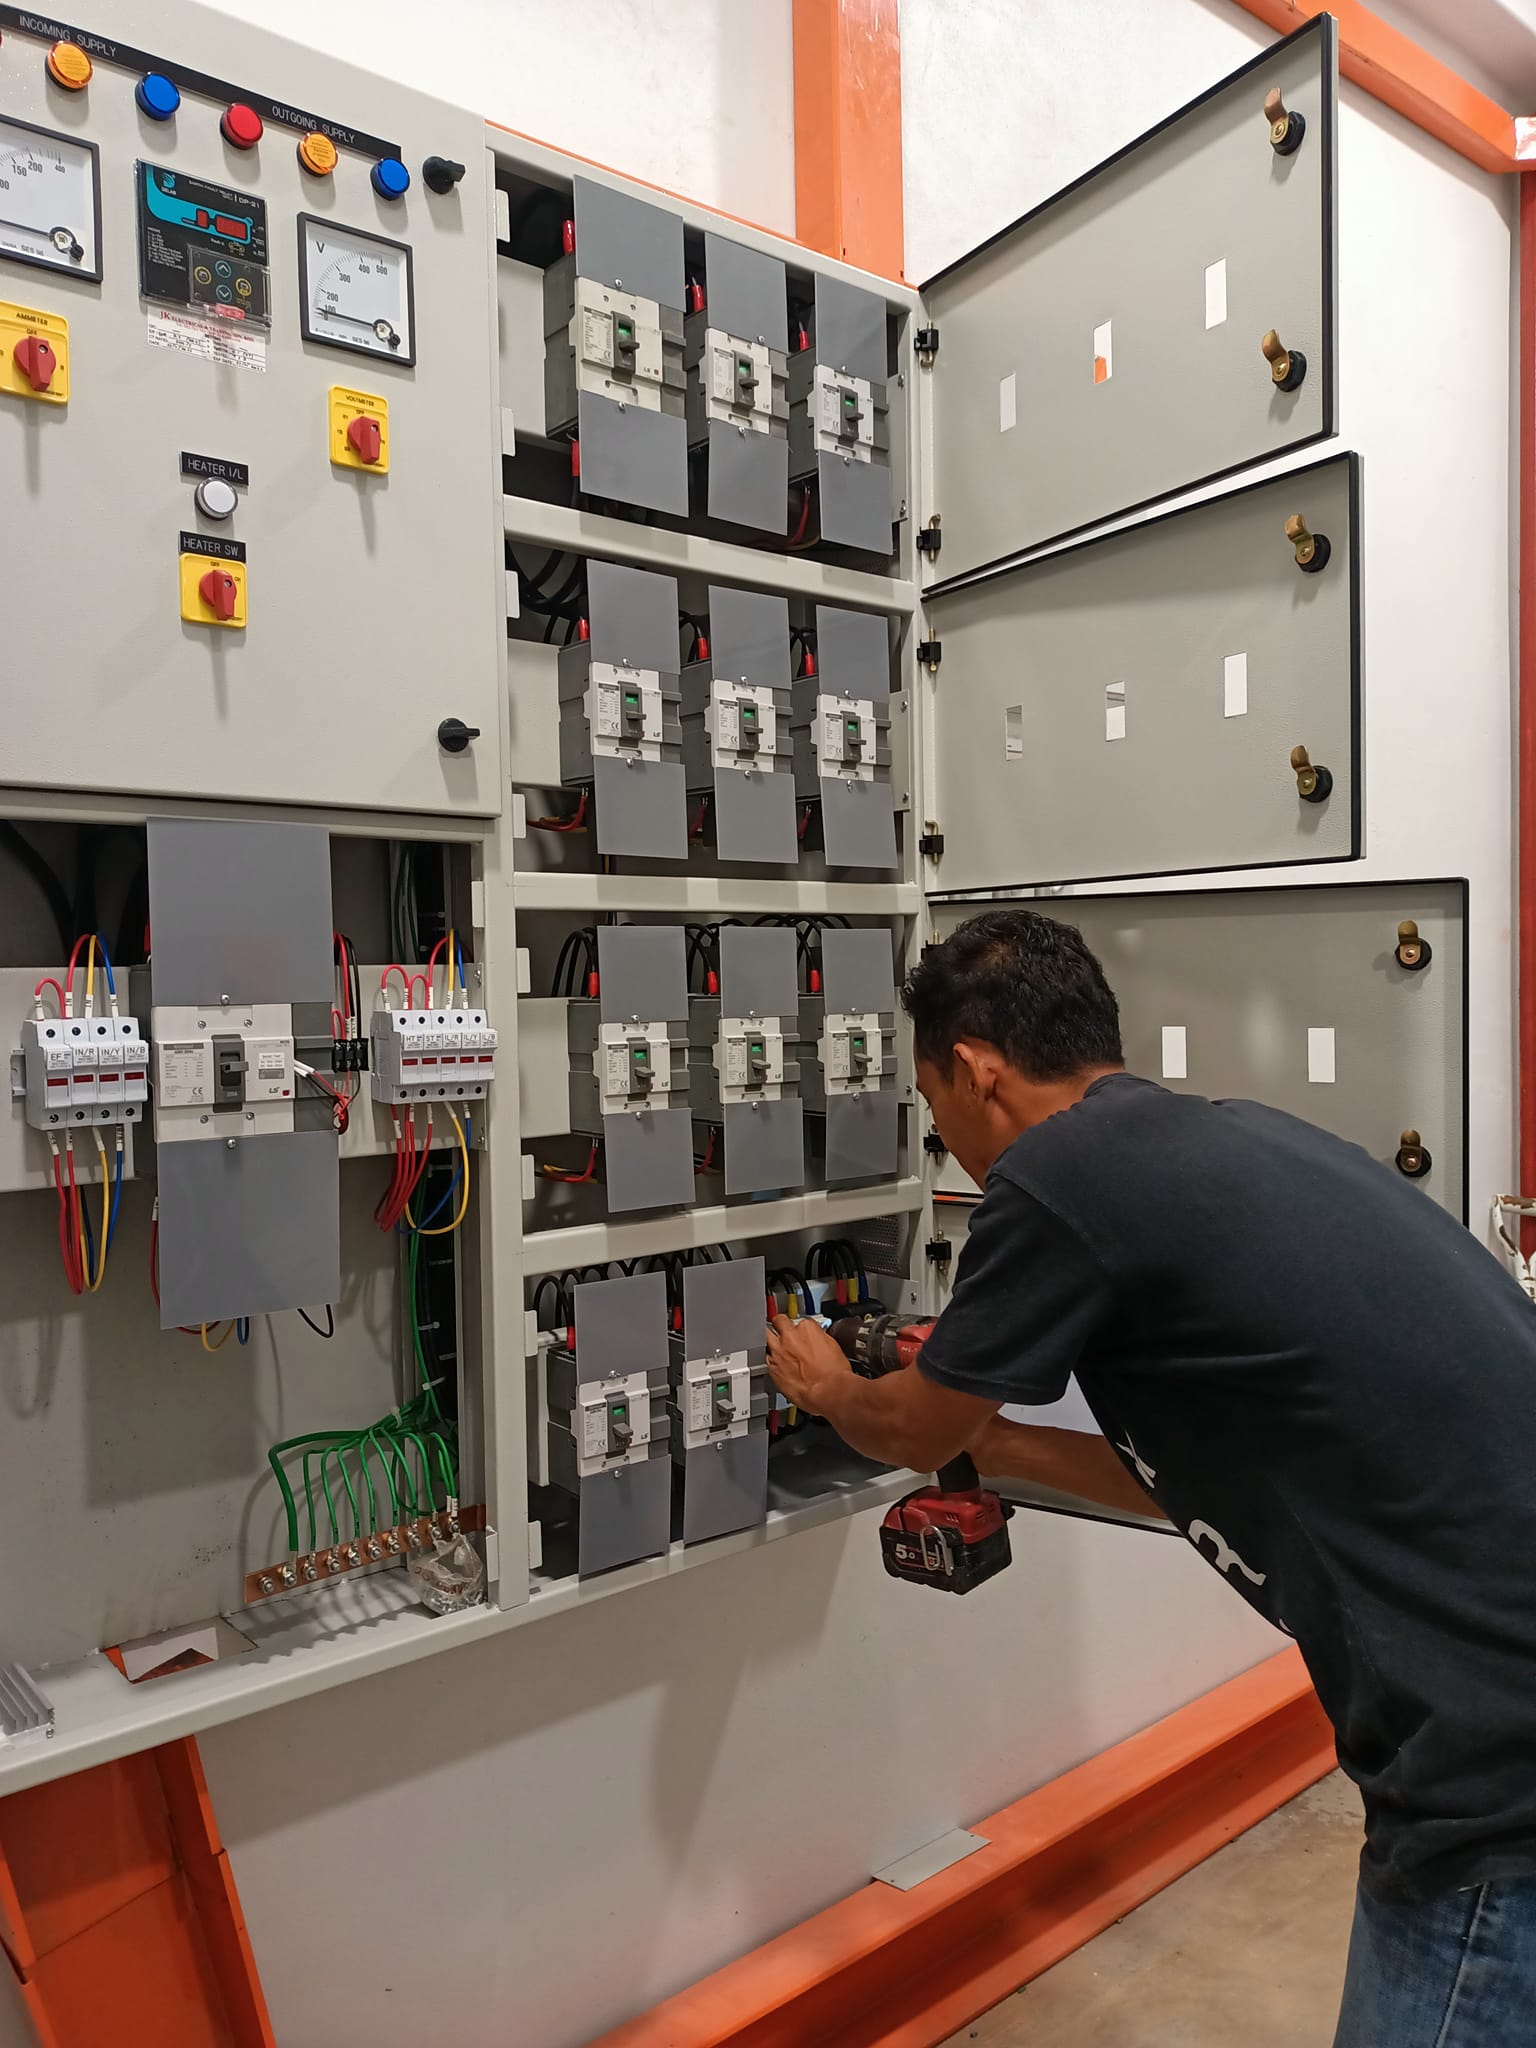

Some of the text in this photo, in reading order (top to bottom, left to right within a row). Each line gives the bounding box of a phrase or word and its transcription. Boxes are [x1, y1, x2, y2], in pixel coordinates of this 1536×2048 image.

[19, 15, 116, 57] INCOMING SUPPLY
[272, 105, 356, 144] OUTGOING SUPPLY
[12, 164, 27, 176] 150
[28, 160, 43, 173] 200
[316, 240, 325, 254] V
[358, 264, 370, 274] 400
[376, 265, 388, 275] 500
[339, 272, 351, 283] 300
[326, 292, 339, 302] 200
[16, 312, 48, 325] AMMETER
[346, 394, 374, 406] VOLTMETER
[188, 458, 226, 476] HEATER
[183, 537, 238, 557] HEATER SW
[75, 1047, 95, 1056] IN/R
[101, 1048, 120, 1056] IN/Y
[127, 1046, 145, 1054] IN/B
[50, 1053, 62, 1061] EF
